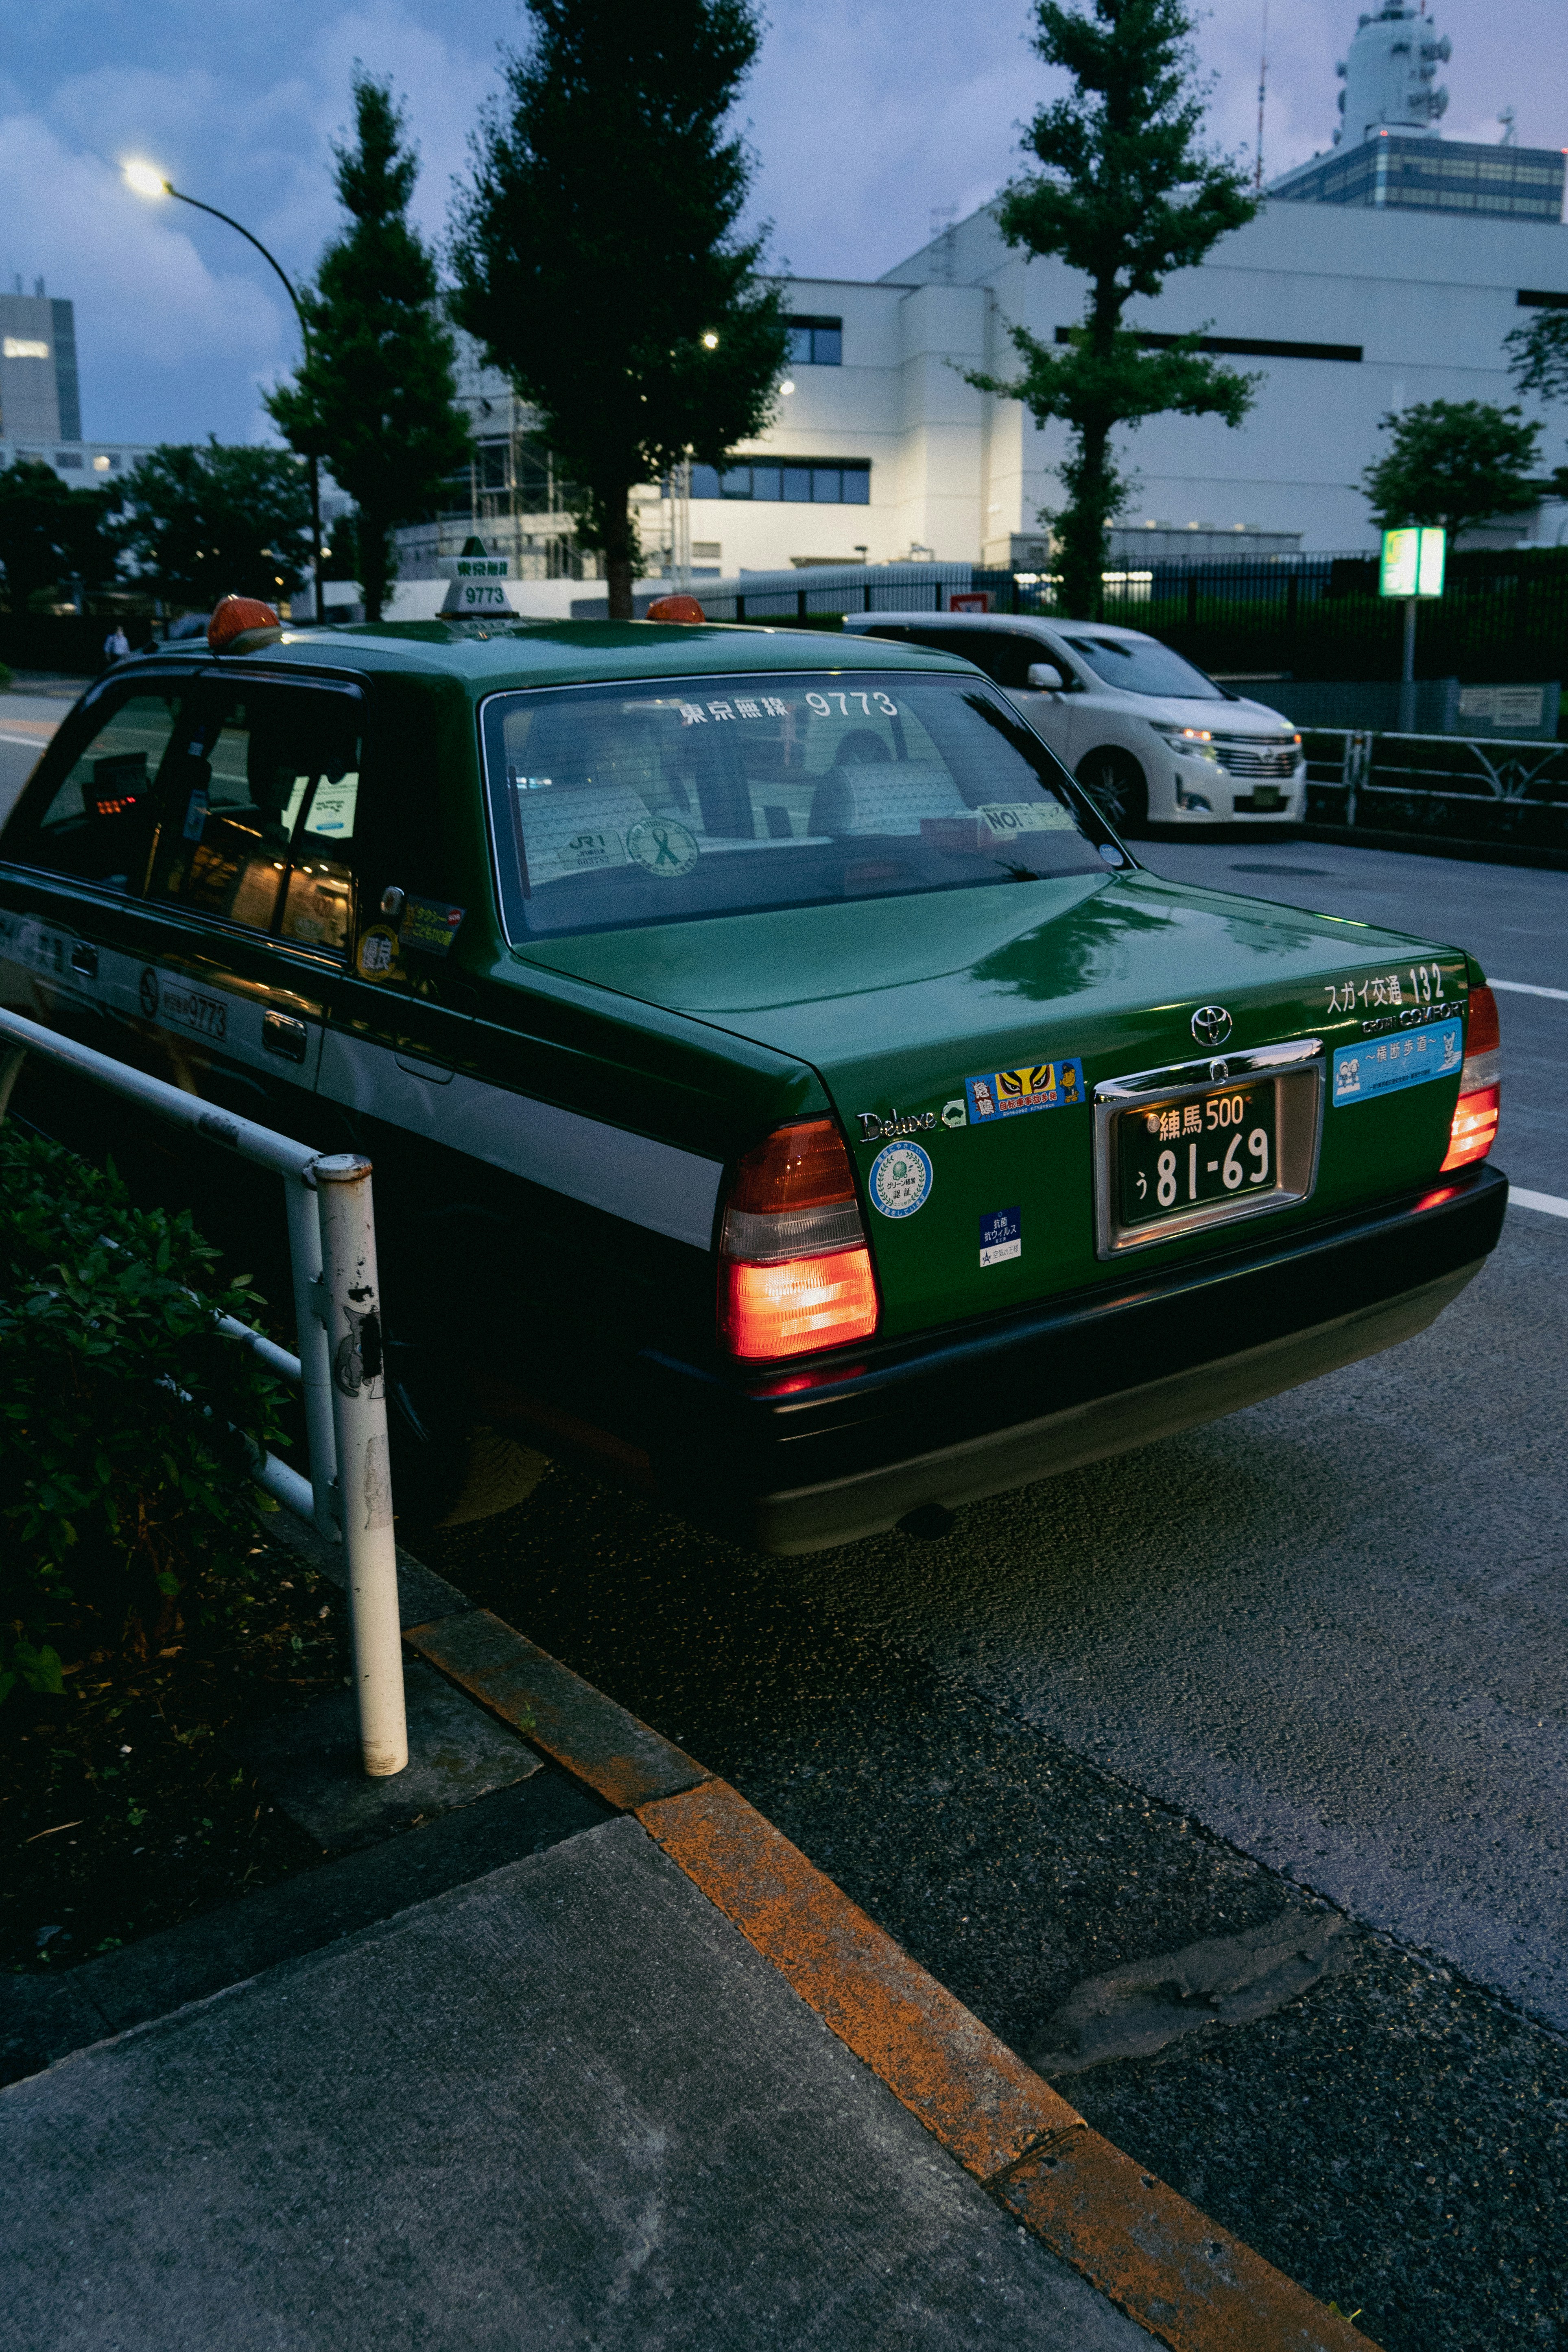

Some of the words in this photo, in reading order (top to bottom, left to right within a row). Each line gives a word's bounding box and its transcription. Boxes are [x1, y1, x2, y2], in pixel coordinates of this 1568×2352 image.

[465, 586, 504, 604] 9773
[679, 697, 788, 724] 東京無線
[805, 692, 898, 717] 9773
[363, 936, 393, 971] 優良
[1324, 975, 1402, 1014] スガイ交通
[1409, 963, 1444, 1004] 132
[189, 994, 227, 1037] 9773
[1399, 999, 1468, 1027] COMFORT
[974, 1082, 995, 1116] 危険
[998, 1091, 1057, 1112] 自転車事故多発
[856, 1108, 937, 1143] Deluxe
[1160, 1104, 1202, 1141] 練馬
[1206, 1096, 1243, 1130] 500
[887, 1177, 916, 1190] グリーン経営
[1136, 1171, 1147, 1199] う
[1157, 1128, 1269, 1207] 81-69
[984, 1225, 1017, 1242] 抗ウィルス
[994, 1217, 1007, 1229] 抗菌
[993, 1244, 1019, 1259] 空気の王様
